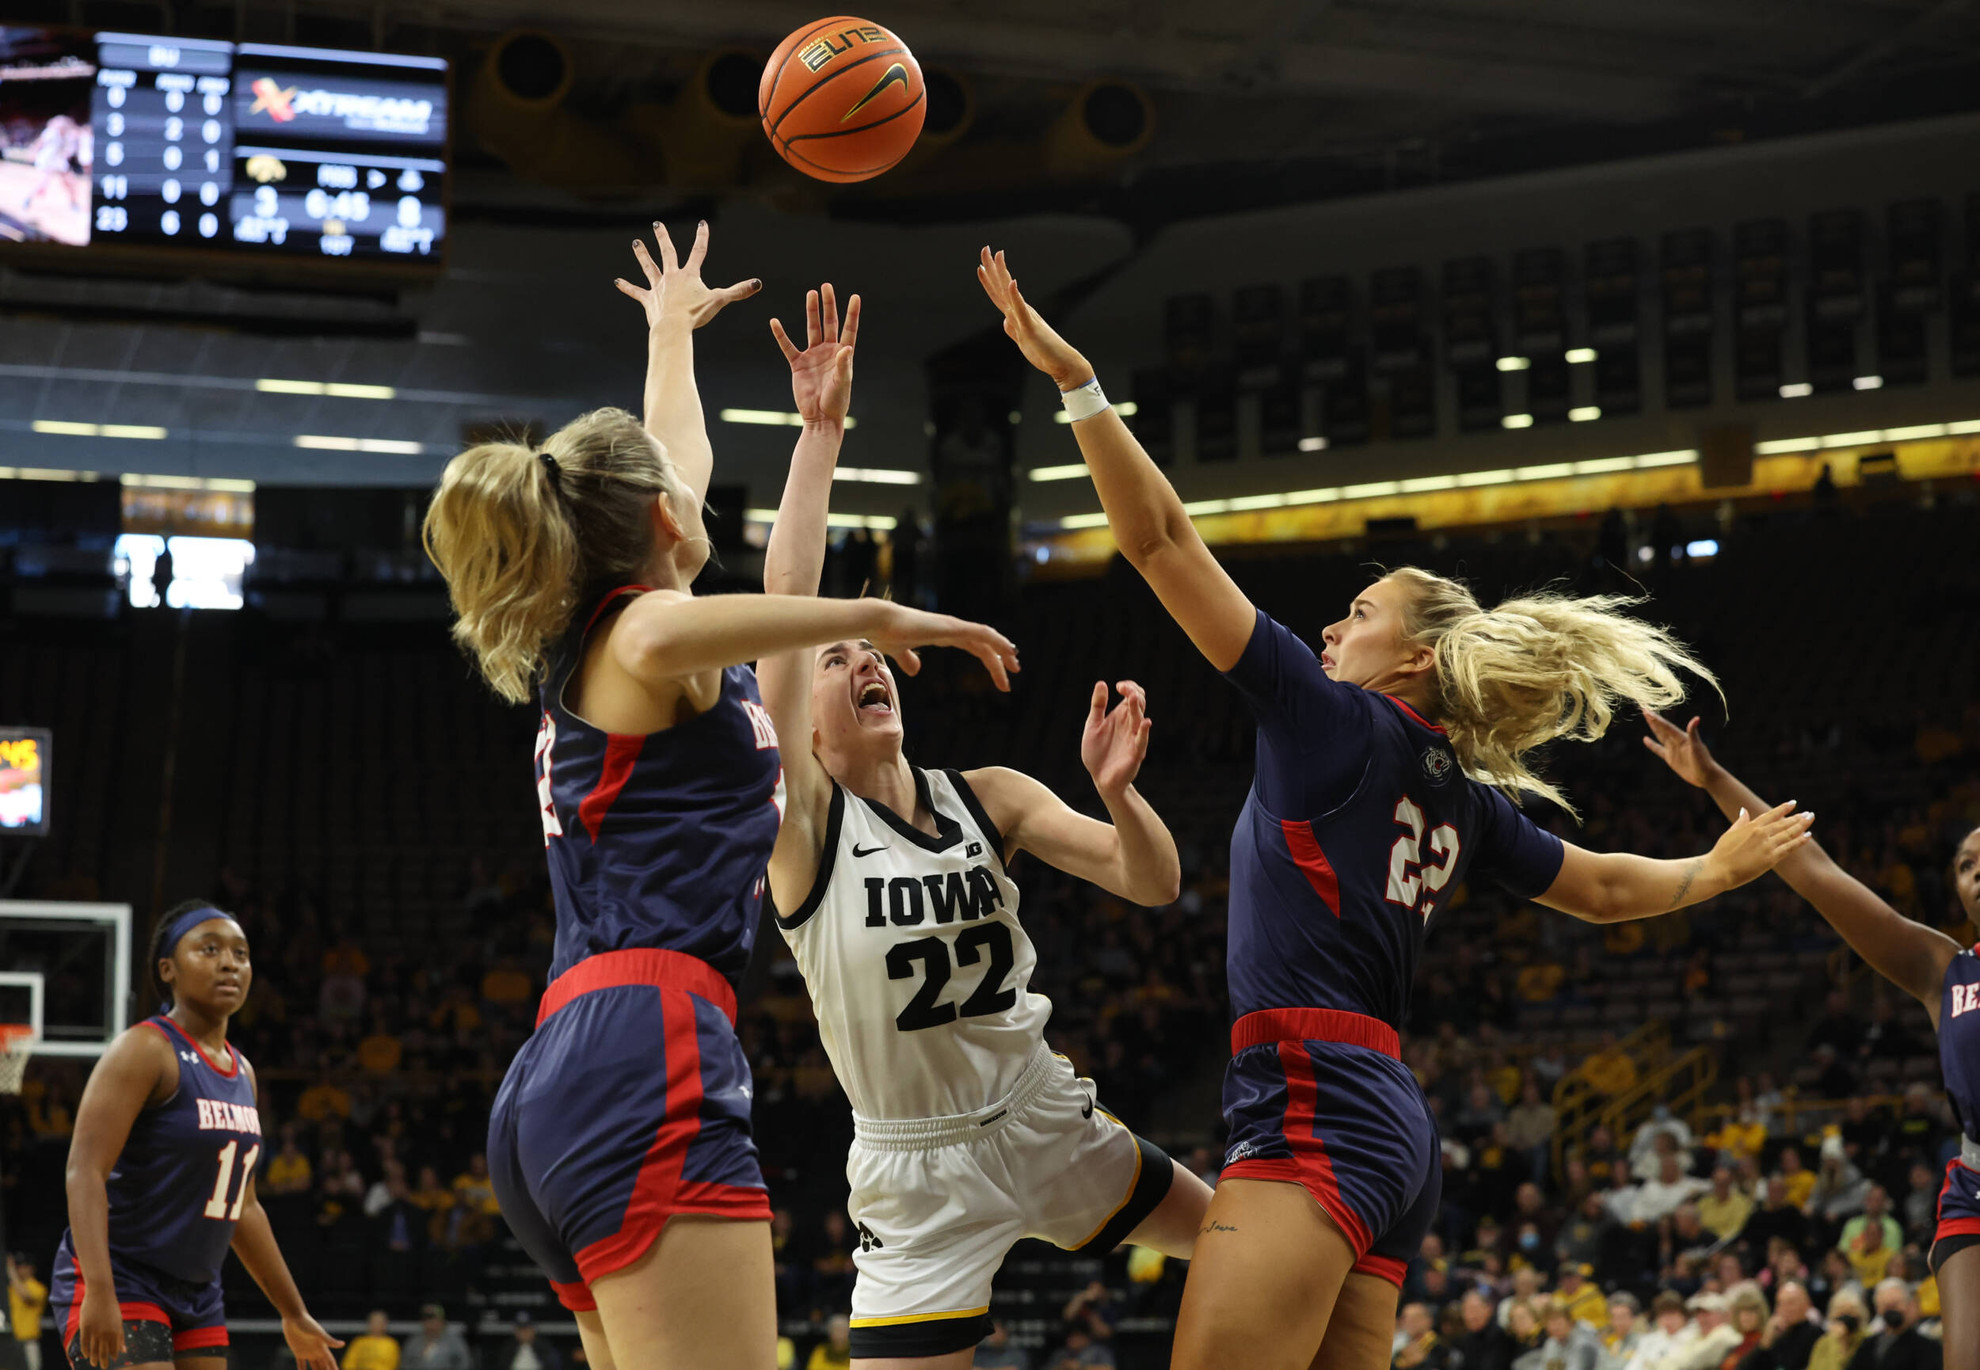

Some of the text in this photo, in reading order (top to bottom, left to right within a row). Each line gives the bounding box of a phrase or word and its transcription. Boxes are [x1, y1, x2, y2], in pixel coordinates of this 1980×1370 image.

[801, 27, 887, 74] ELITE
[102, 175, 127, 198] 11
[254, 186, 278, 218] 3
[1385, 794, 1461, 927] 22
[864, 865, 1005, 927] IOWA
[885, 921, 1017, 1031] 22
[203, 1138, 260, 1221] 11
